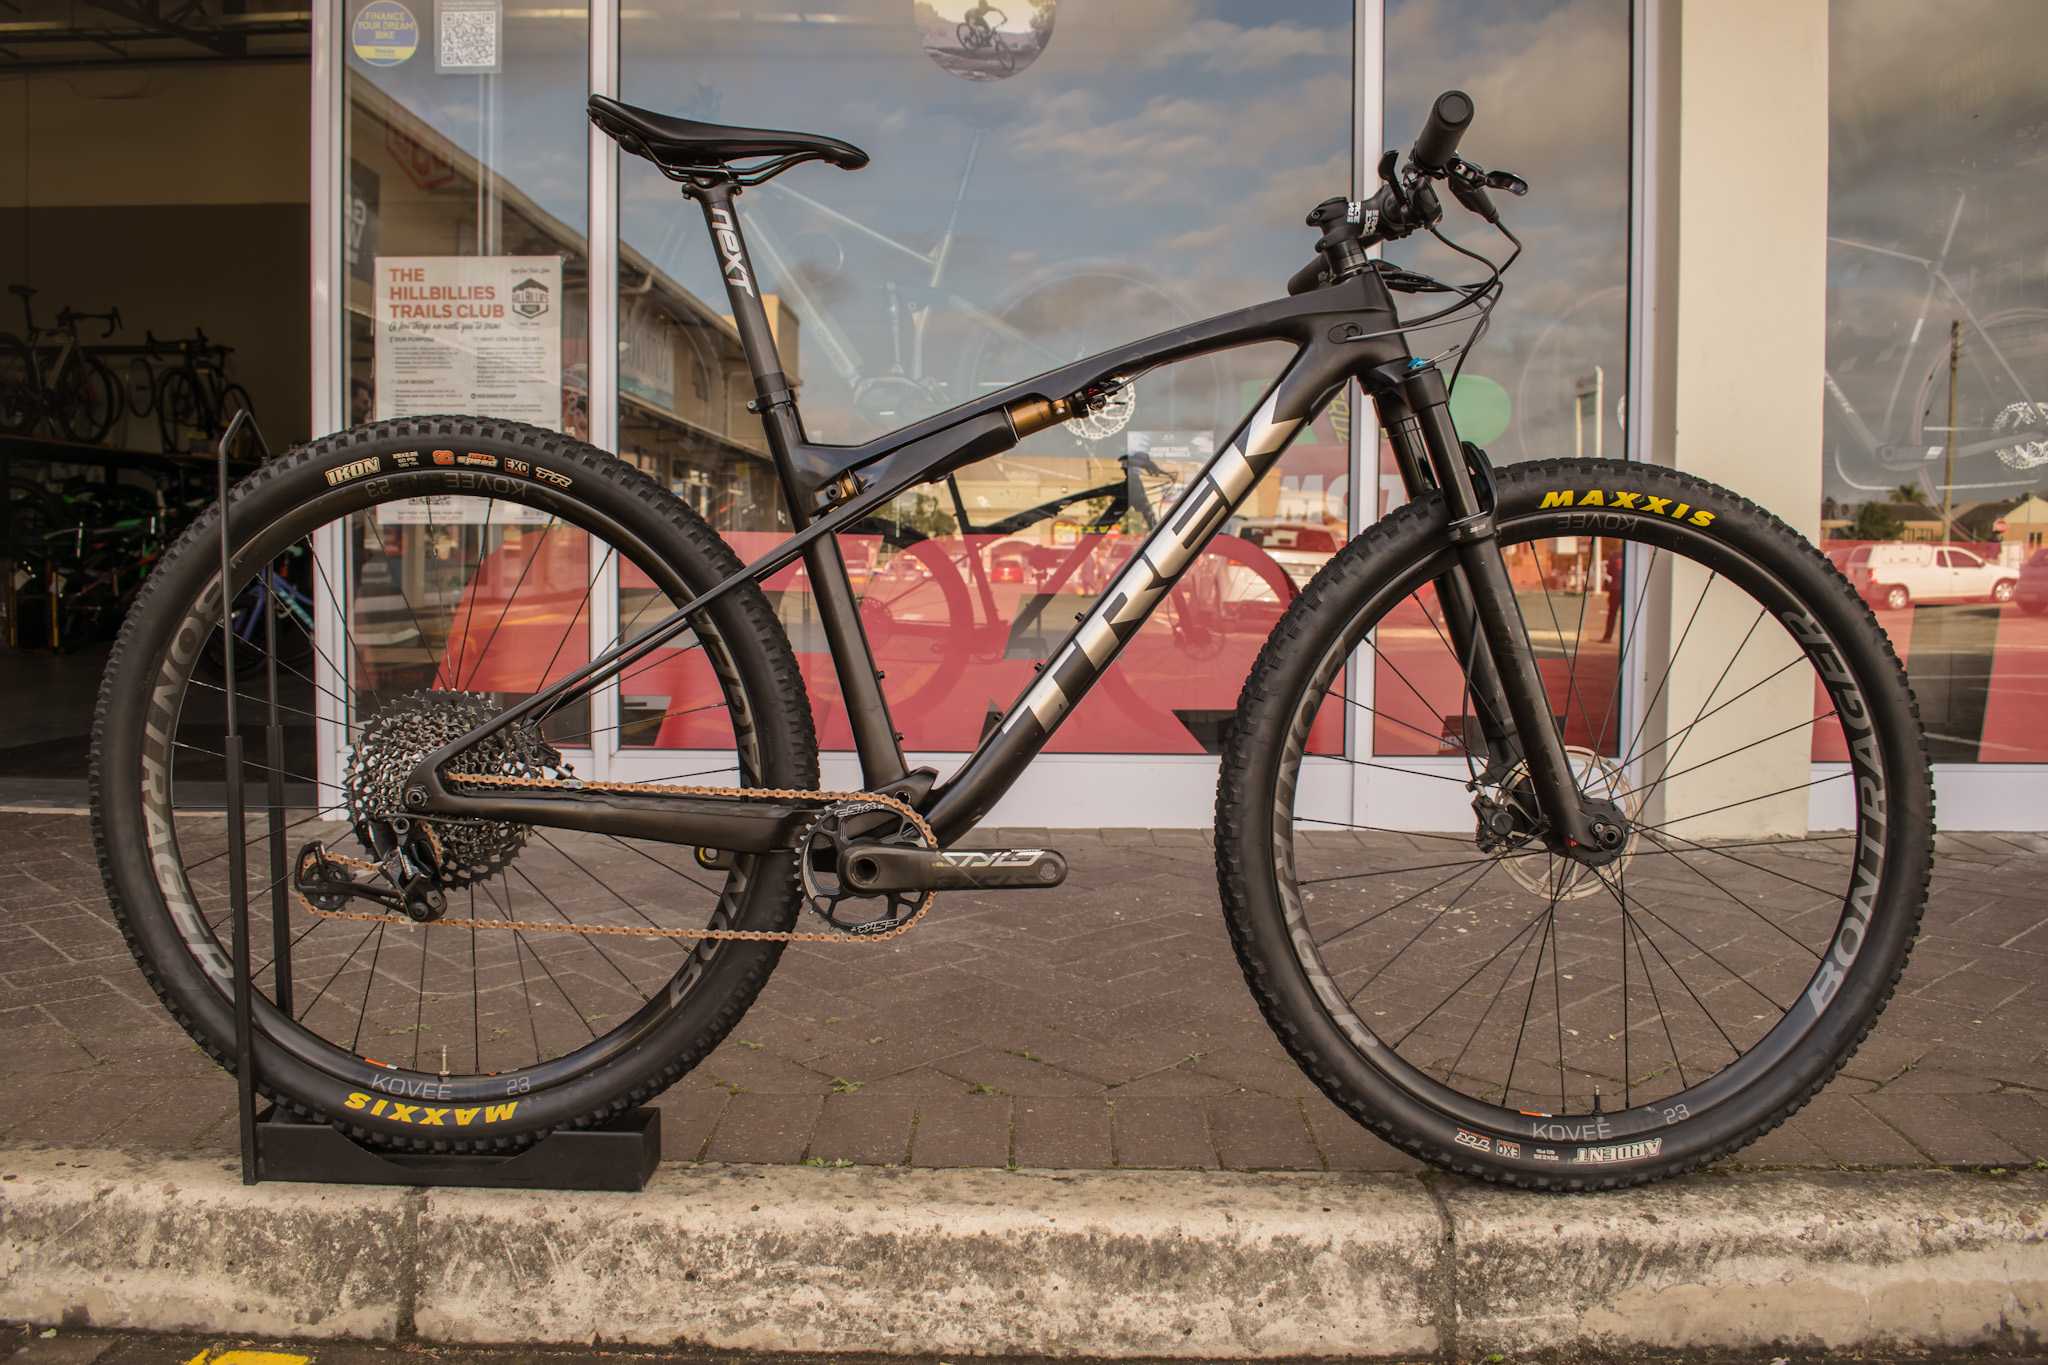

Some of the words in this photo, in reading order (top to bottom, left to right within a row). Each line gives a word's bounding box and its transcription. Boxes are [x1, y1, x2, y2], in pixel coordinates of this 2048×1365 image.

[389, 268, 424, 282] THE
[390, 286, 496, 301] HILLBILLIES
[390, 304, 452, 319] TRAILS
[457, 304, 505, 319] CLUB
[325, 457, 381, 487] IKON
[504, 458, 530, 474] EXO
[444, 472, 528, 497] KOVEE
[1539, 489, 1717, 527] MAXXIS
[1556, 513, 1641, 532] KOVEE
[1002, 384, 1304, 735] TREK
[1781, 608, 1888, 1018] BONTRAGER
[371, 1073, 453, 1101] KOVEE
[506, 1076, 531, 1097] 23
[344, 1091, 519, 1126] MAXXIS
[1663, 1103, 1692, 1126] 23
[1532, 1122, 1613, 1143] KOVEE
[1496, 1142, 1520, 1159] EXO
[1574, 1137, 1664, 1164] ARDENT
